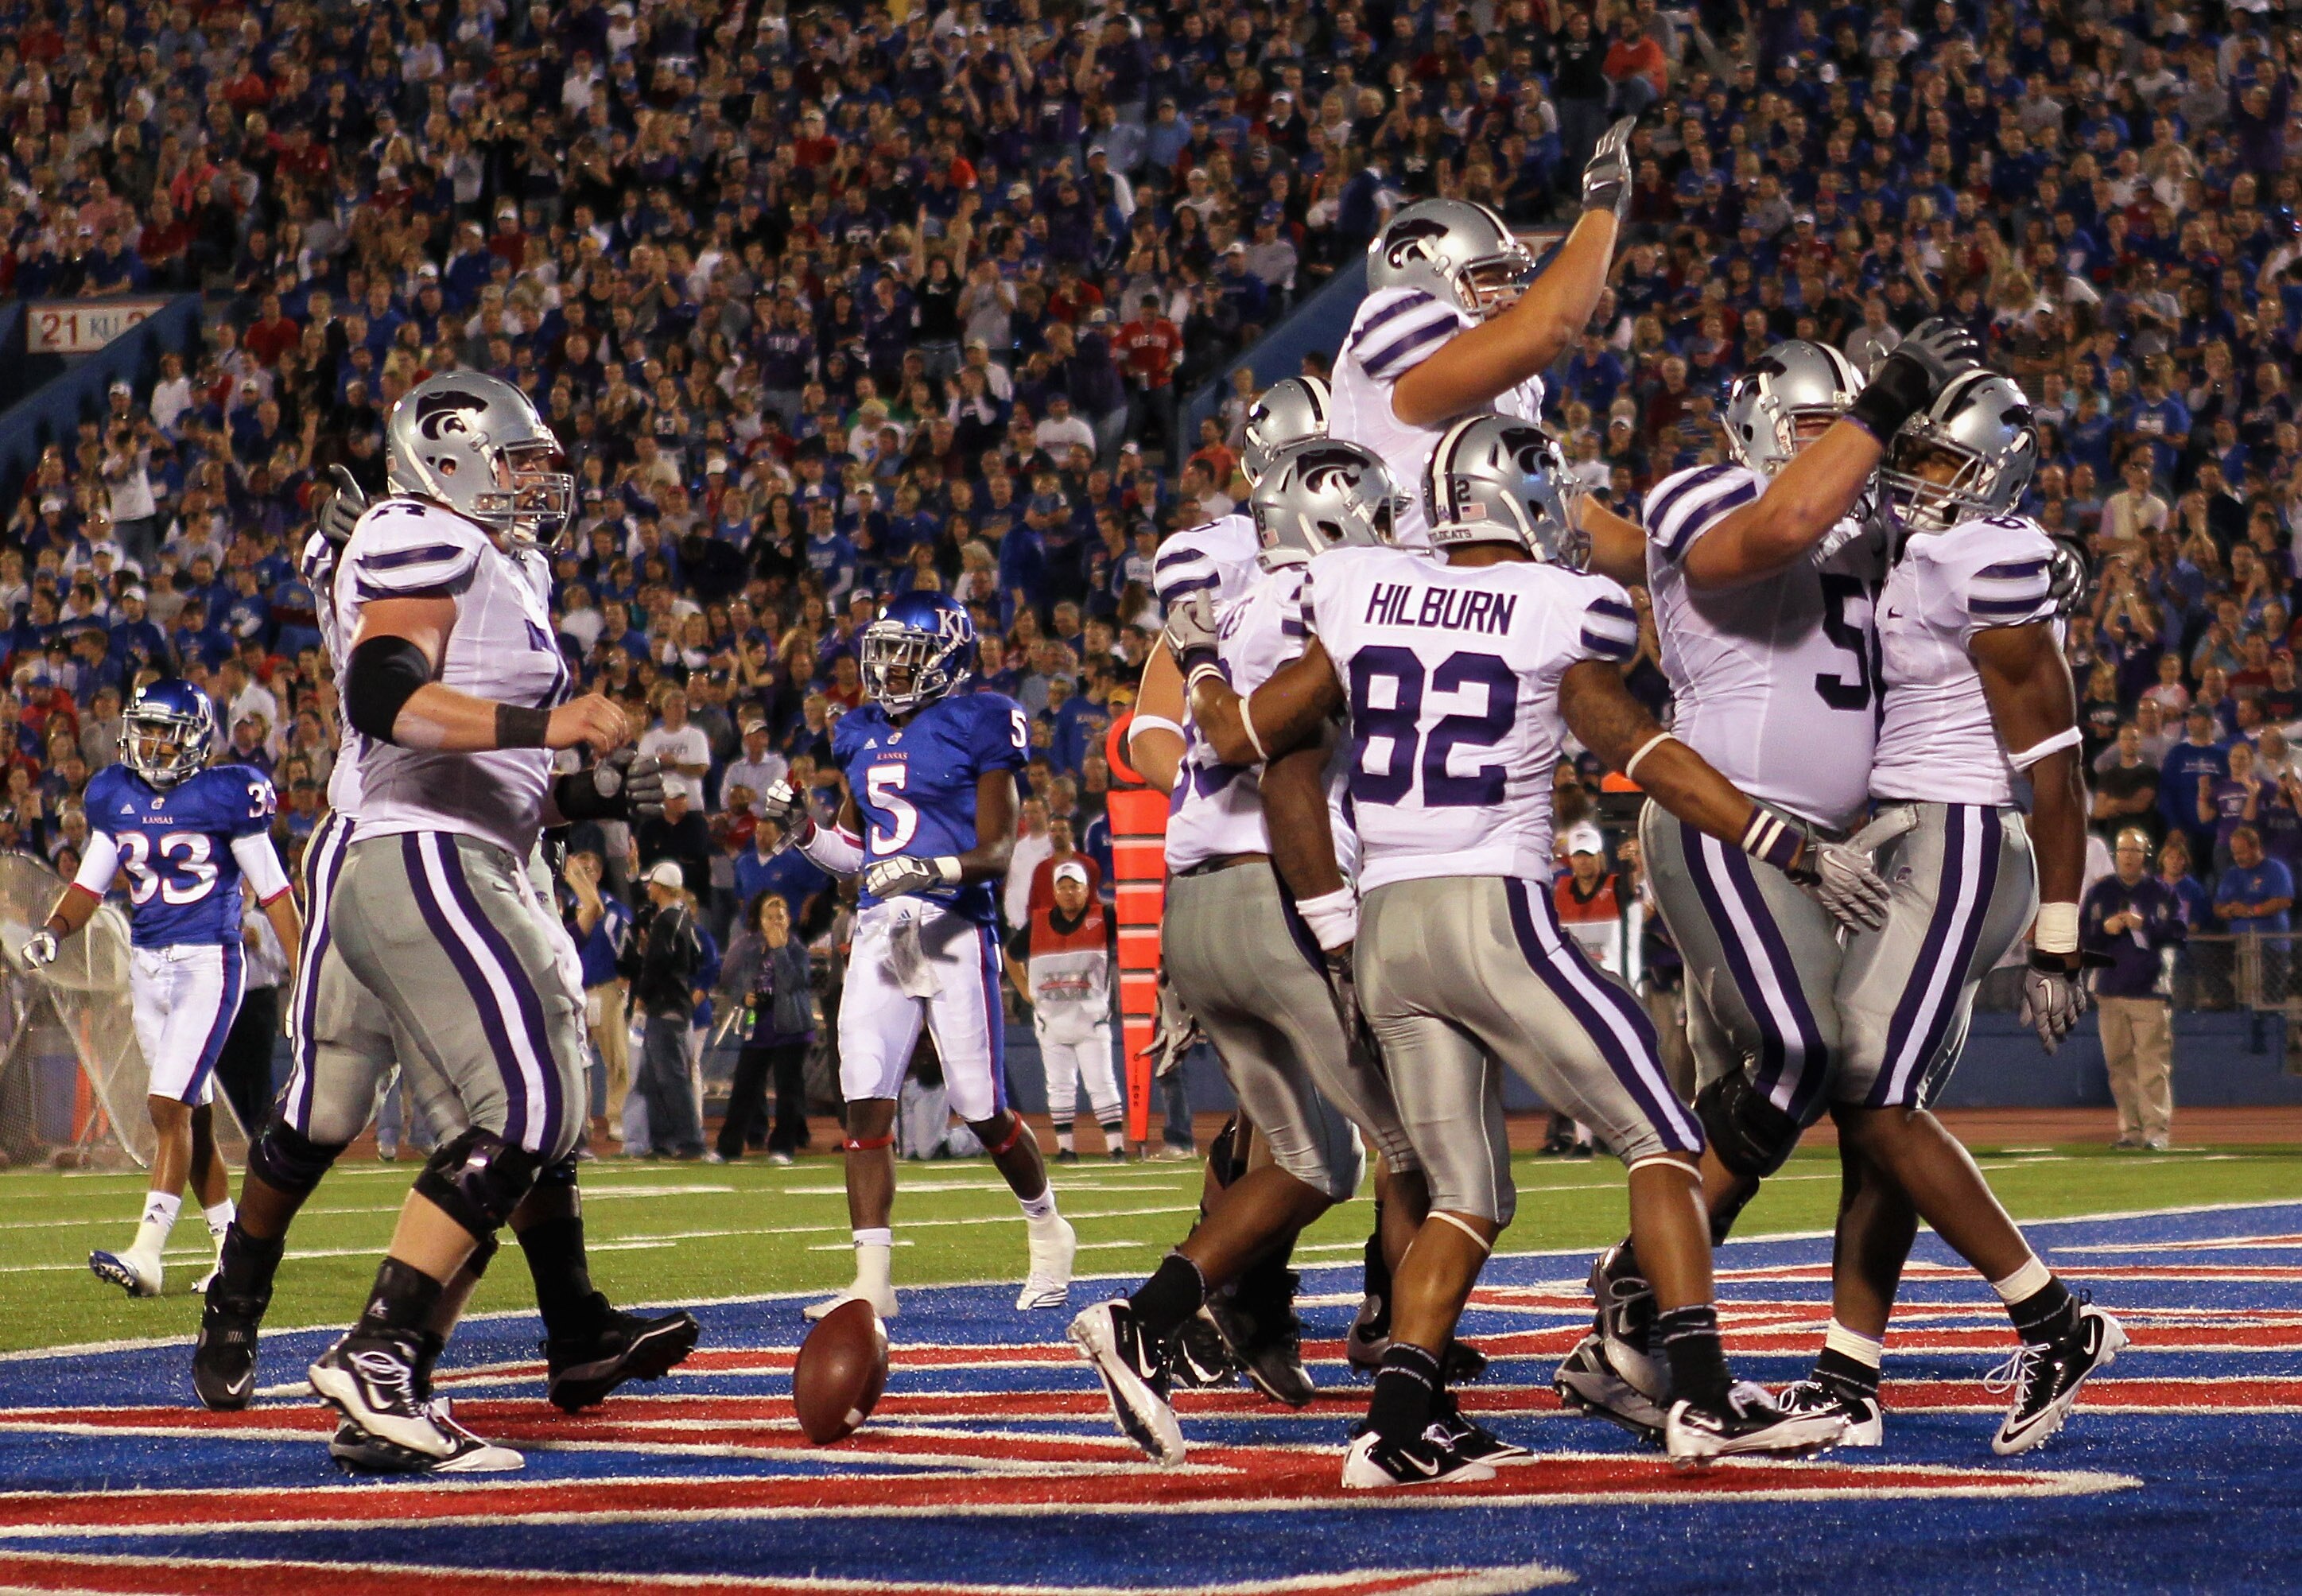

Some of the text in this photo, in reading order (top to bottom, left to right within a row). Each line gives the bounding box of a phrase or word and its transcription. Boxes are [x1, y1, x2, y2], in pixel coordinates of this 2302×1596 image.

[41, 313, 79, 345] 21
[88, 316, 118, 341] KU
[935, 608, 972, 646] KU
[1364, 582, 1519, 636] HILBURN
[1010, 709, 1027, 750] 5
[1347, 645, 1519, 807] 82
[876, 751, 909, 761] KANSAS
[142, 816, 173, 825] KANSAS
[866, 763, 918, 856] 5
[115, 830, 219, 905] 33
